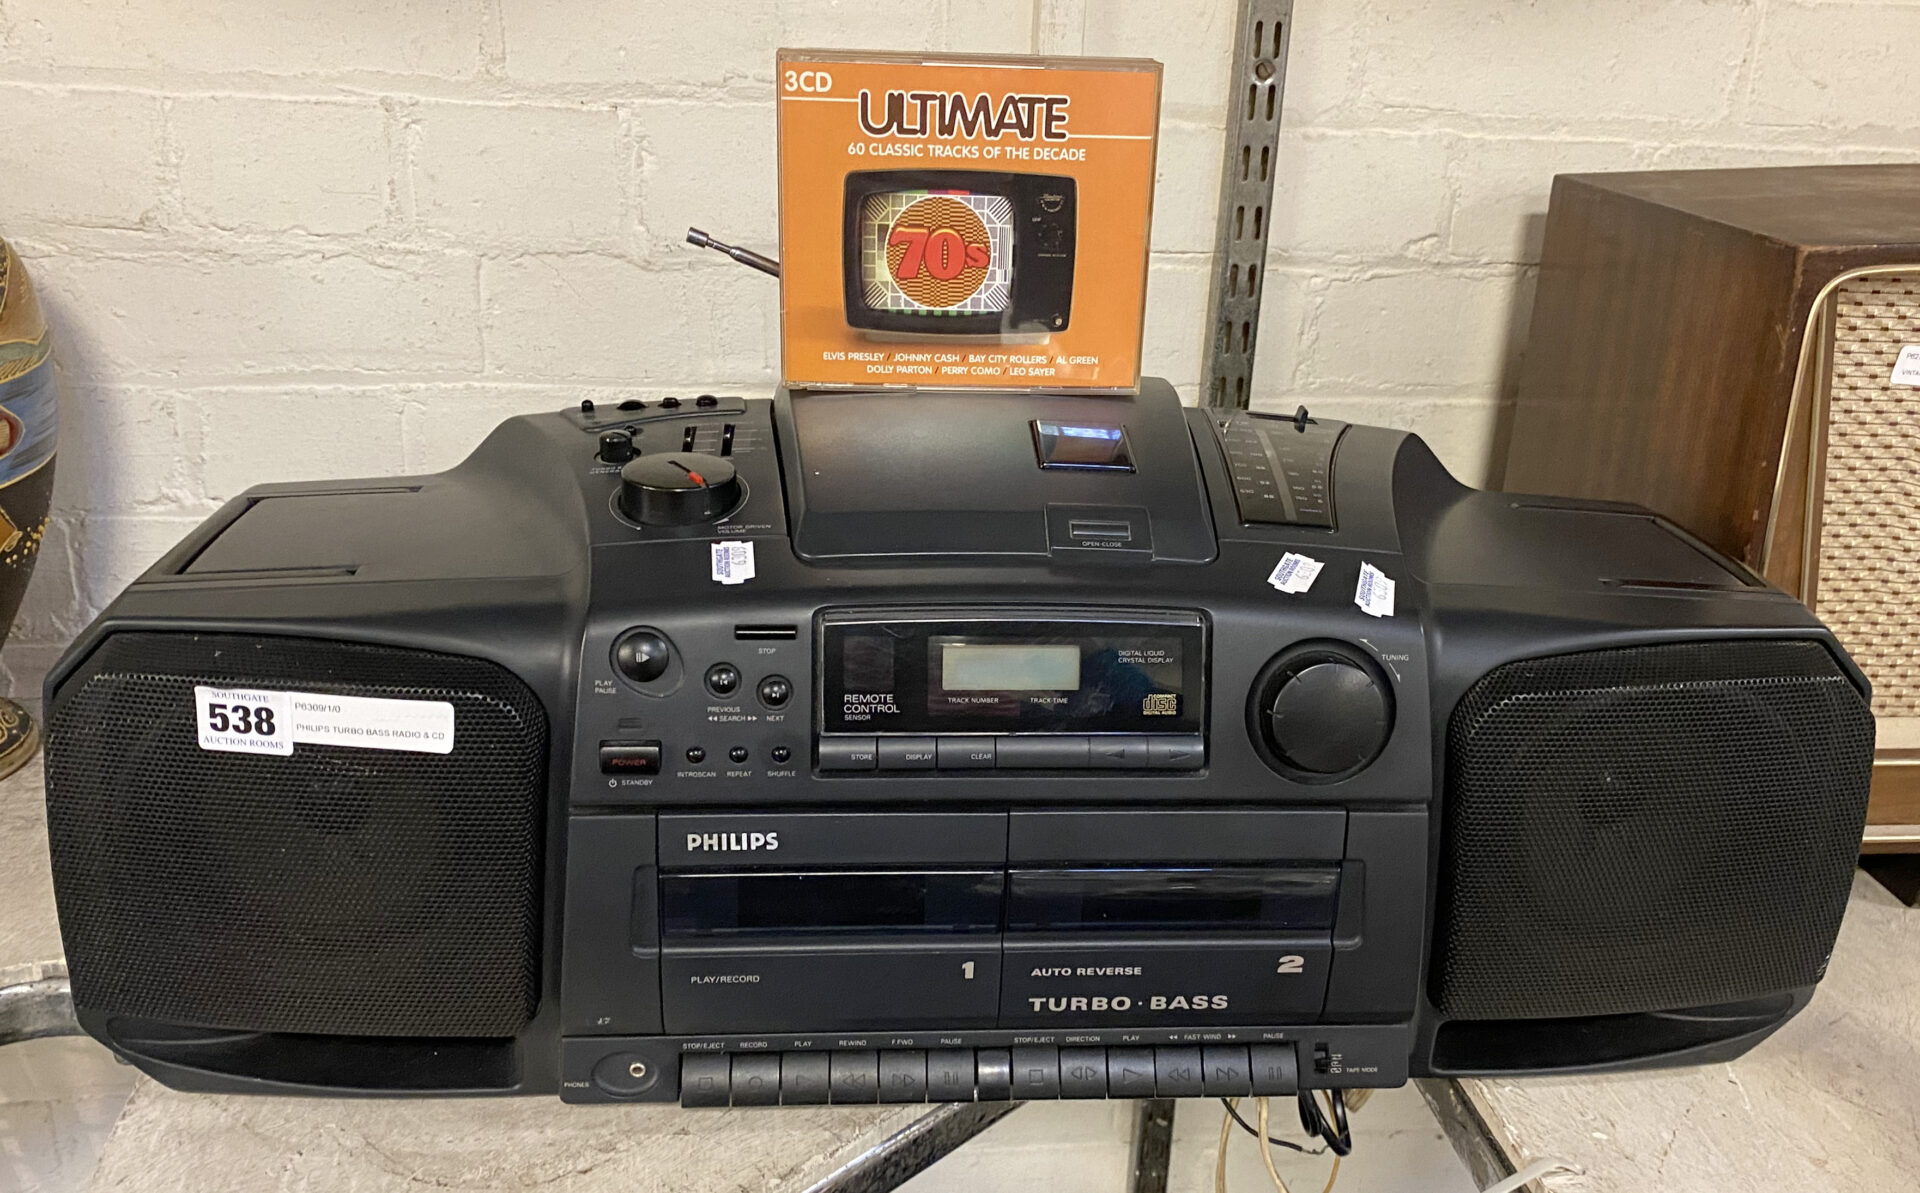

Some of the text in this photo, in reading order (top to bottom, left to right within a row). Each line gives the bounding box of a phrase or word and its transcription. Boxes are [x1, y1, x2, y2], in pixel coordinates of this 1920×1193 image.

[785, 71, 832, 92] 3CD
[858, 89, 1070, 141] ULTIMATE
[847, 143, 1086, 161] 60 CLASSIC TRACKS OF THE DECADE
[823, 352, 845, 361] ELVIS
[848, 352, 884, 362] PRESLEY
[893, 353, 932, 363] JOHNNY
[934, 353, 960, 363] CASH
[968, 354, 987, 364] BAY
[988, 354, 1008, 364] CITY
[1010, 355, 1047, 365] ROLLERS
[1056, 355, 1067, 365] AL
[1069, 356, 1099, 365] GREEN
[866, 365, 894, 375] DOLLY
[896, 365, 933, 375] PARTON
[941, 366, 969, 376] PERRY
[970, 366, 1001, 376] COMO
[1009, 367, 1027, 376] LEO
[1028, 367, 1056, 377] SAYER
[1147, 657, 1174, 665] DISPLAY
[211, 691, 270, 702] SOUTHGATE
[843, 694, 894, 704] REMOTE
[843, 704, 900, 714] CONTROL
[208, 702, 276, 736] 538
[296, 723, 331, 734] PHILIPS
[333, 725, 364, 736] TURBO
[366, 727, 391, 737] BASS
[392, 729, 421, 739] RADIO
[431, 731, 445, 740] CD
[203, 735, 285, 750] AUCTION ROOMS
[612, 758, 647, 766] POWER
[905, 753, 933, 761] DISPLAY
[687, 832, 779, 851] PHILIPS
[1277, 955, 1305, 973] 2
[961, 961, 975, 980] 1
[1031, 967, 1142, 977] AUTO REVERSE
[690, 975, 760, 985] PLAY/RECORD
[1028, 995, 1229, 1012] TURBO BASS
[1013, 1036, 1056, 1044] STOP/EJECT
[1065, 1035, 1101, 1043] DIRECTION
[1184, 1033, 1221, 1041] FAST WIND
[682, 1042, 725, 1050] STOP/EJECT
